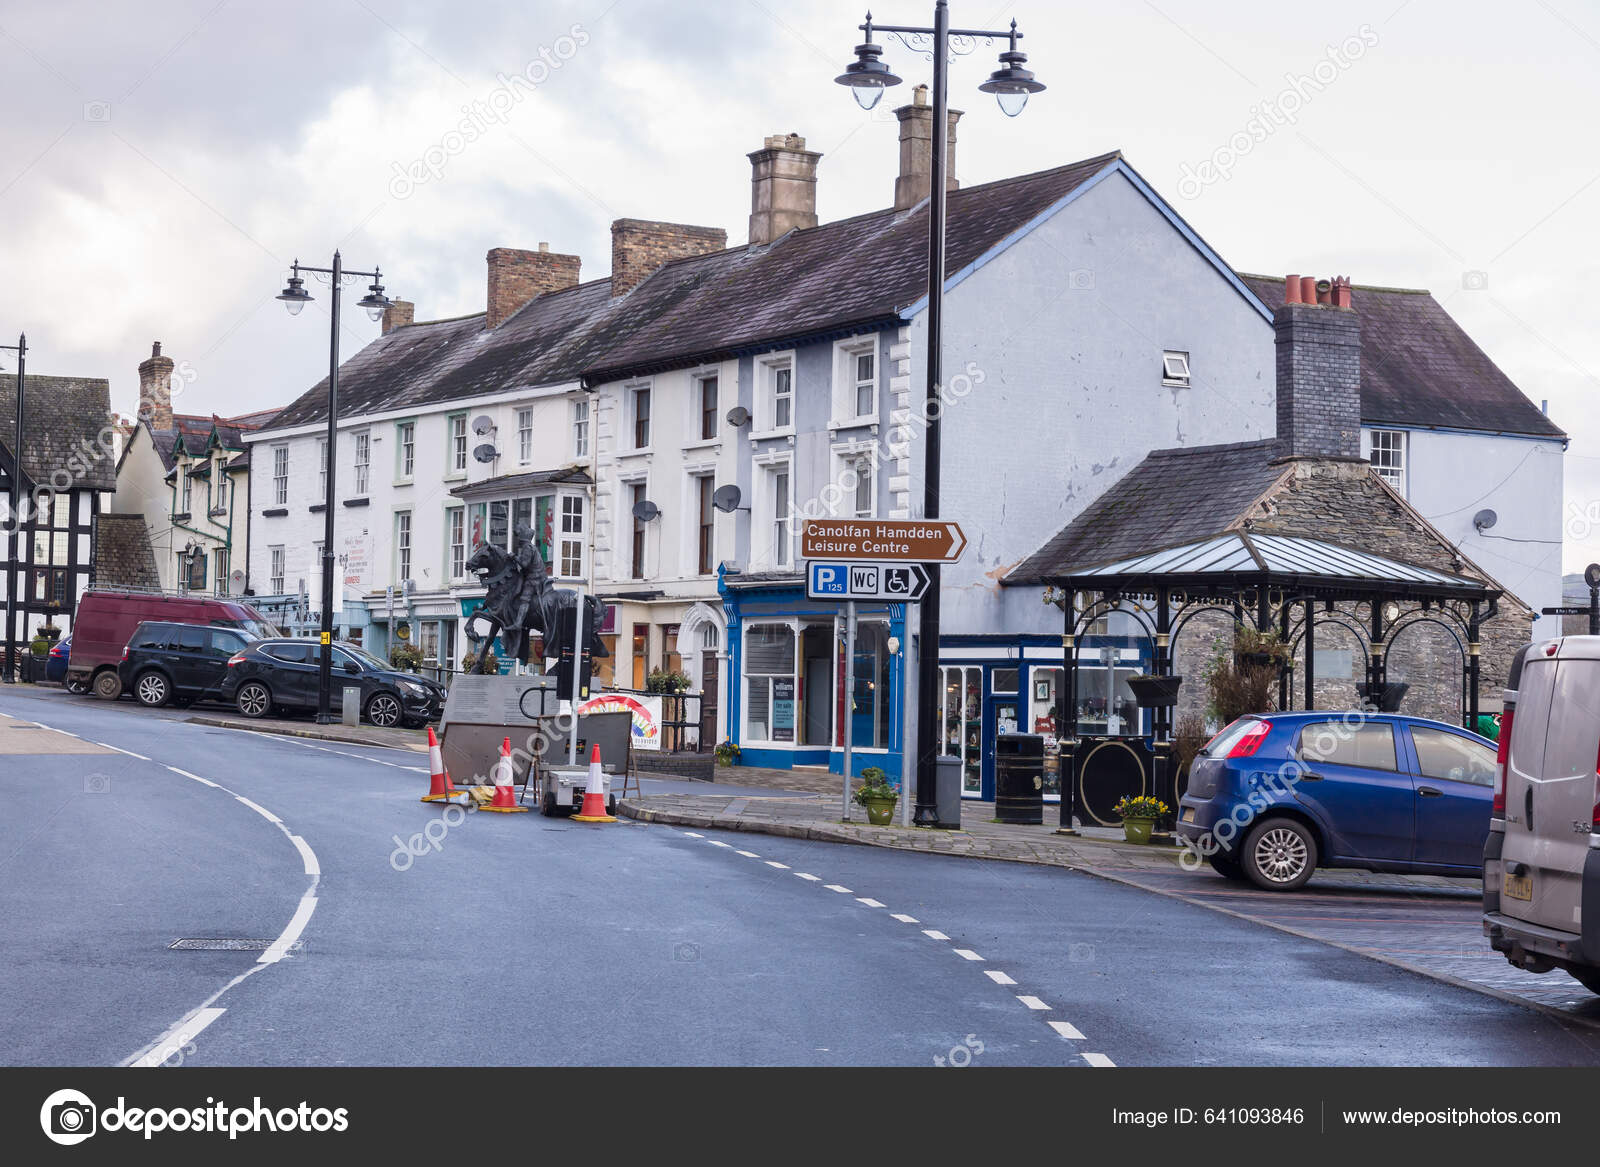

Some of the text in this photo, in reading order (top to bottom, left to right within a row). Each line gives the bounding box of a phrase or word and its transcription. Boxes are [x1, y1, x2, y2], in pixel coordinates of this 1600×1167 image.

[807, 524, 942, 539] Canolfan Hamdden
[807, 540, 910, 554] Leisure Centre
[817, 568, 842, 592] P 125
[854, 572, 876, 588] WC
